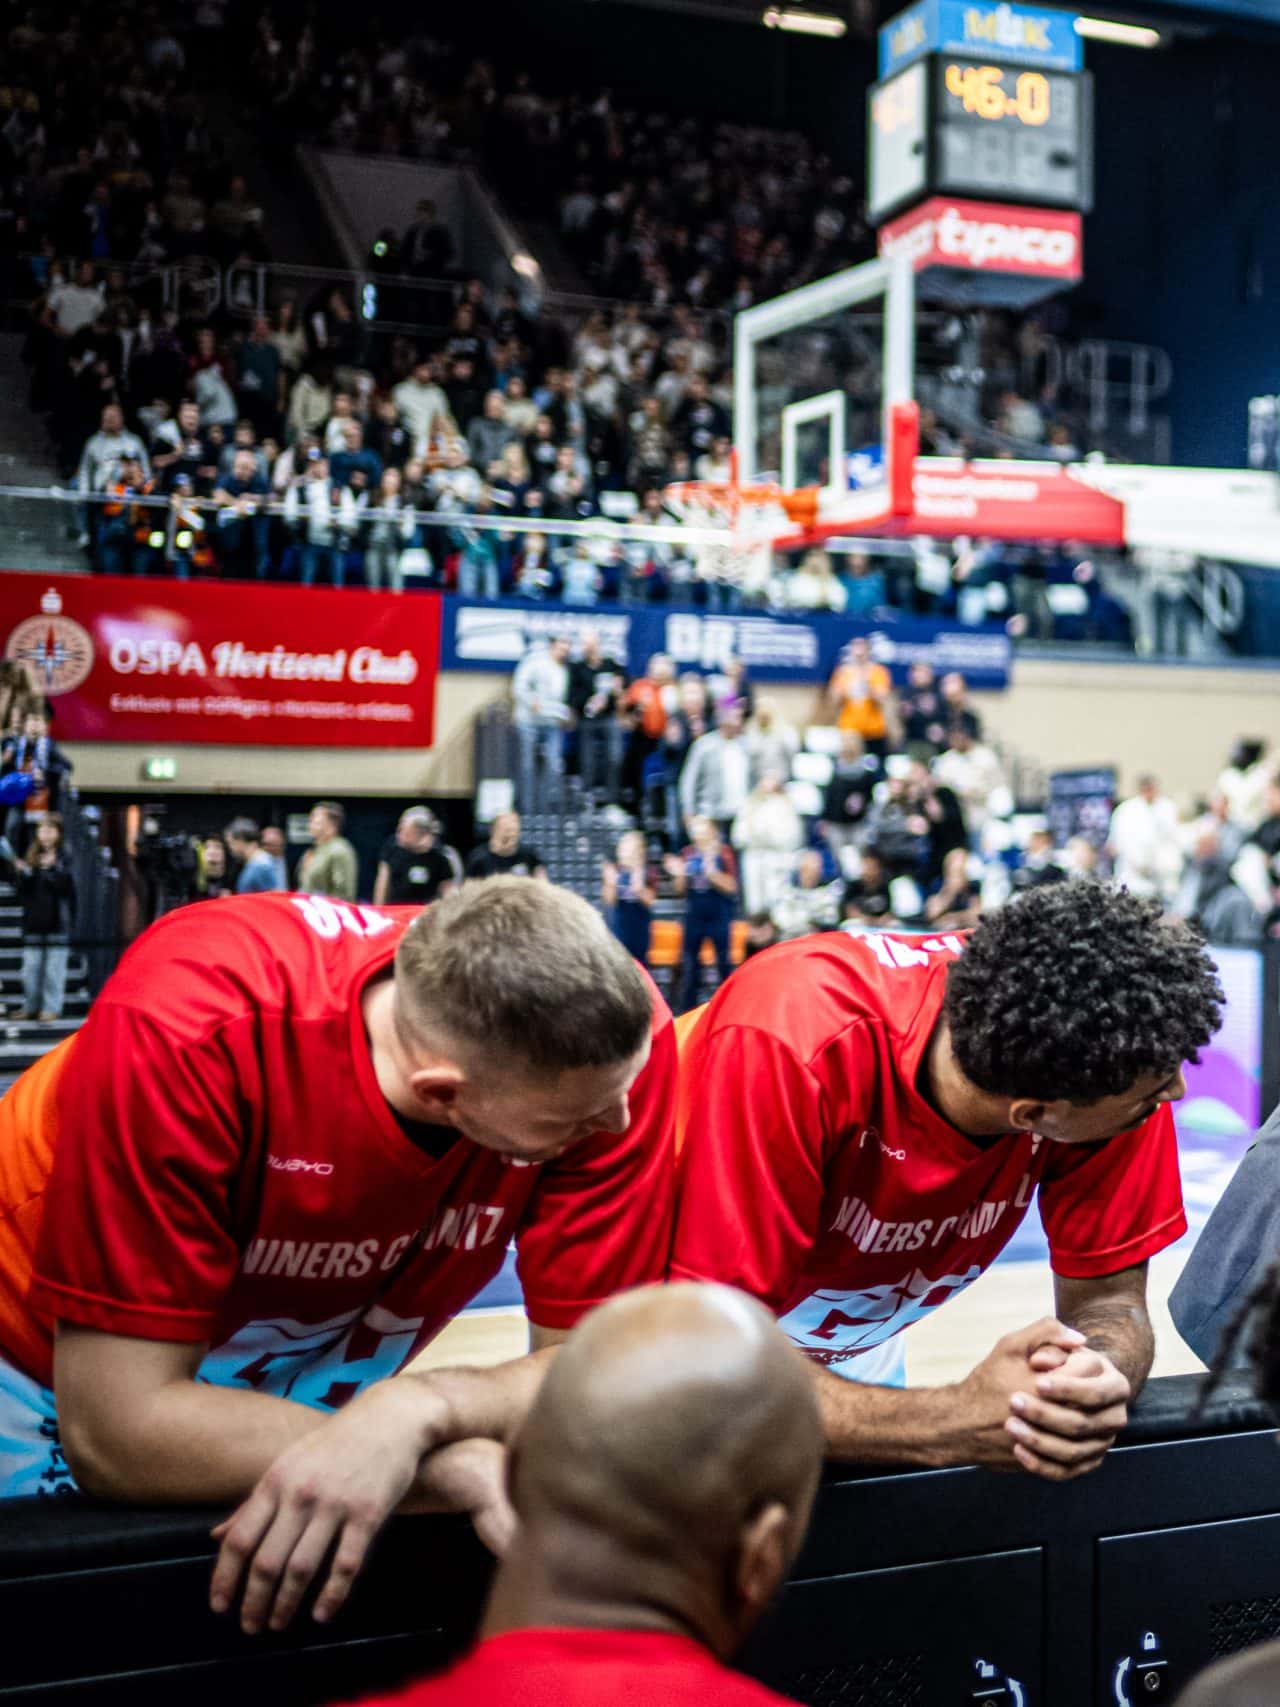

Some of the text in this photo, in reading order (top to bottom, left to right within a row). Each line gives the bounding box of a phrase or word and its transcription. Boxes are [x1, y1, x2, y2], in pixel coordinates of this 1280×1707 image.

[109, 637, 418, 685] OSPA Horizont Club
